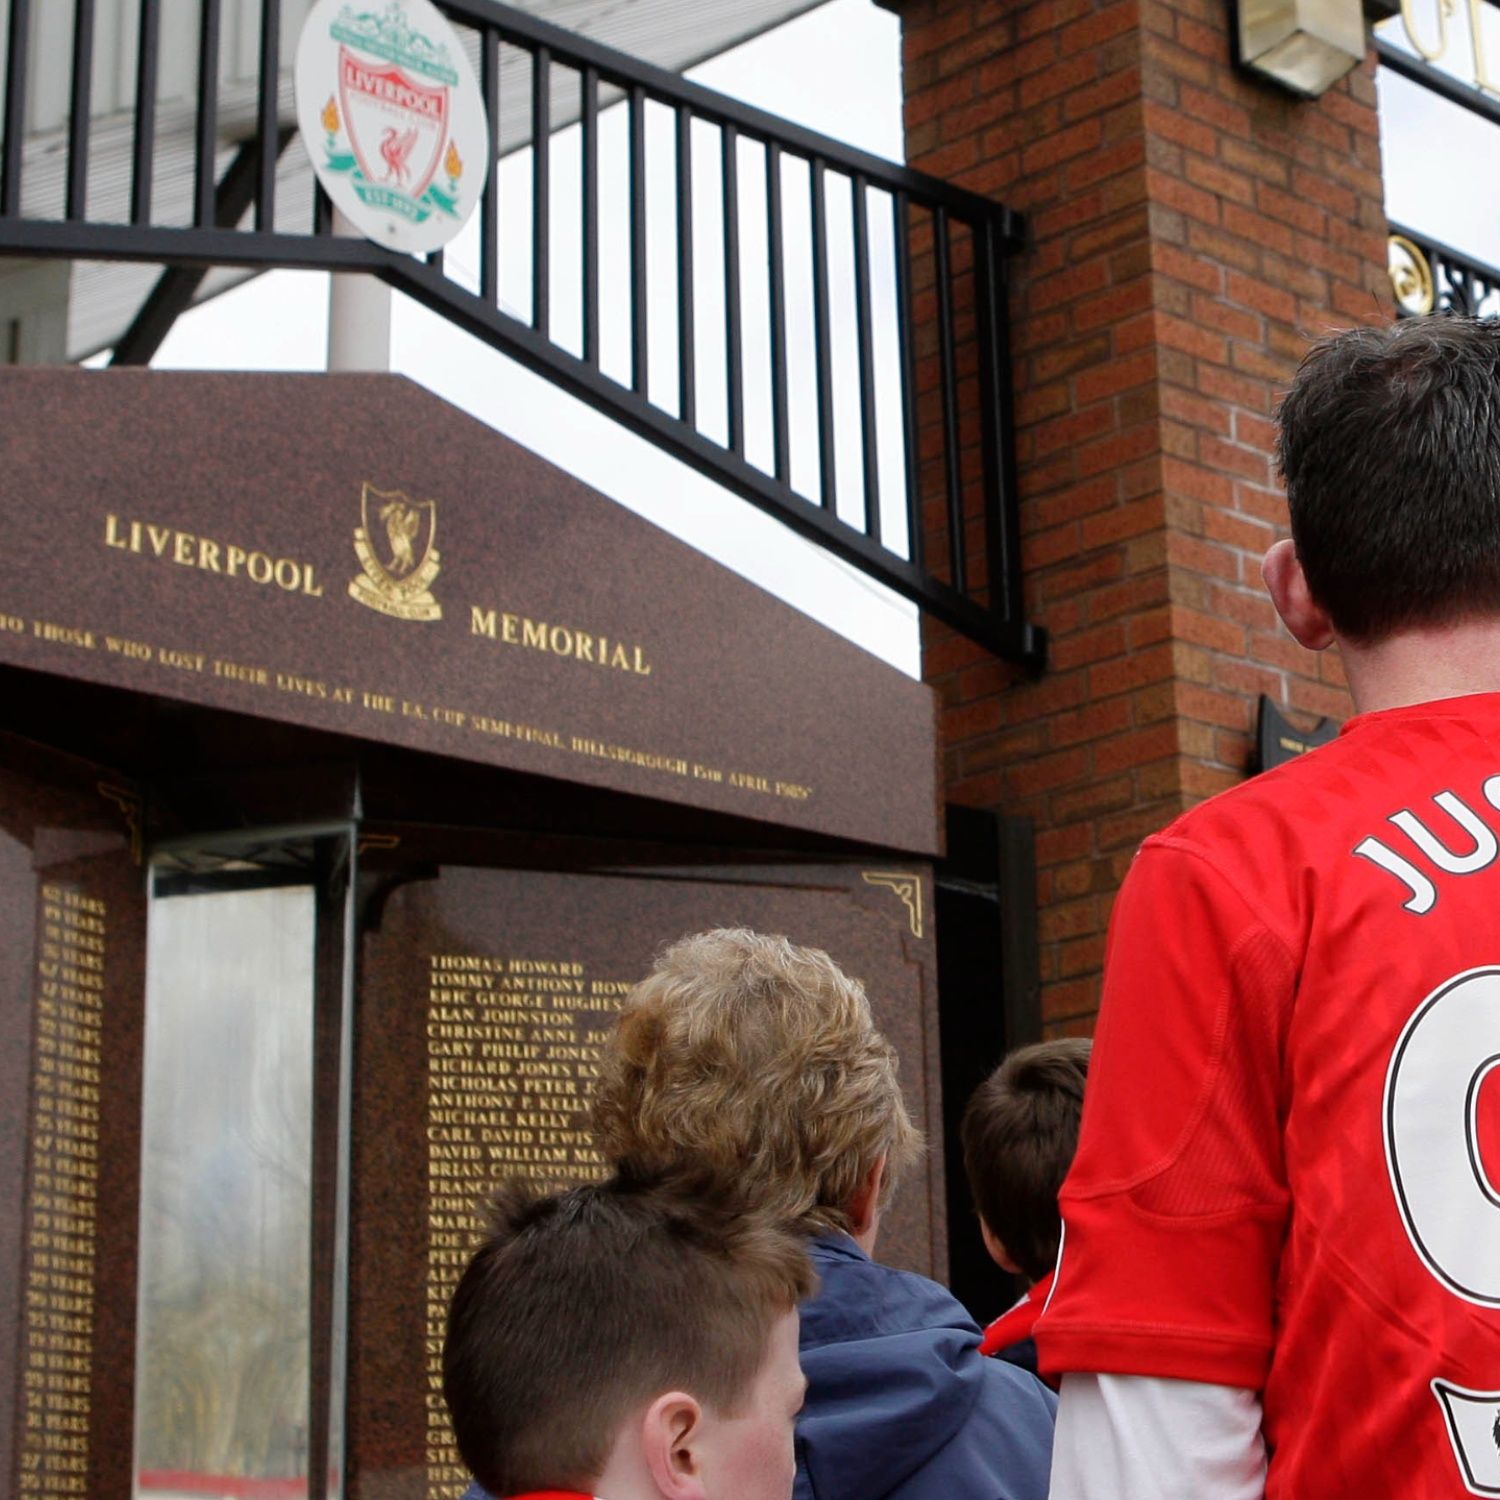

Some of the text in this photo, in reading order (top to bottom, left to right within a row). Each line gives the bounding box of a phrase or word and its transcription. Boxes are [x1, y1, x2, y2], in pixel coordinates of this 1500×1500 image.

[344, 64, 443, 117] LIVERPOOL
[105, 514, 324, 598] LIVERPOOL
[469, 605, 652, 676] MEMORIAL
[33, 620, 97, 650] THOSE
[104, 635, 152, 661] WHO
[158, 646, 205, 673] LOST
[213, 660, 268, 686] THEIR
[276, 672, 327, 699] LIVES
[333, 687, 352, 704] AT
[362, 692, 396, 713] THE
[432, 706, 466, 728] CUP
[571, 735, 688, 777] HILLSBOROUGH
[728, 771, 771, 794] APRIL
[430, 954, 584, 977] THOMAS HOWARD
[430, 972, 632, 996] TOMMY ANTHONY HOW
[429, 988, 623, 1012] ERIC GEORGE HUGHES
[427, 1006, 575, 1026] ALAN JOHNSTON
[426, 1024, 526, 1042] CHRISTINE
[530, 1029, 576, 1044] ANNE
[427, 1041, 600, 1061] GARY PHILIP JONES
[428, 1058, 511, 1076] RICHARD
[515, 1061, 572, 1078] JONES
[428, 1075, 519, 1092] NICHOLAS
[524, 1078, 577, 1095] PETER
[428, 1093, 515, 1109] ANTHONY
[539, 1098, 593, 1113] KELLY
[428, 1110, 571, 1129] MICHAEL KELLY
[426, 1127, 594, 1146] CARL DAVID LEWIS
[428, 1144, 482, 1160] DAVID
[488, 1146, 569, 1162] WILLIAM
[428, 1161, 485, 1177] BRIAN
[428, 1196, 476, 1212] JOHN
[428, 1231, 461, 1247] JOE
